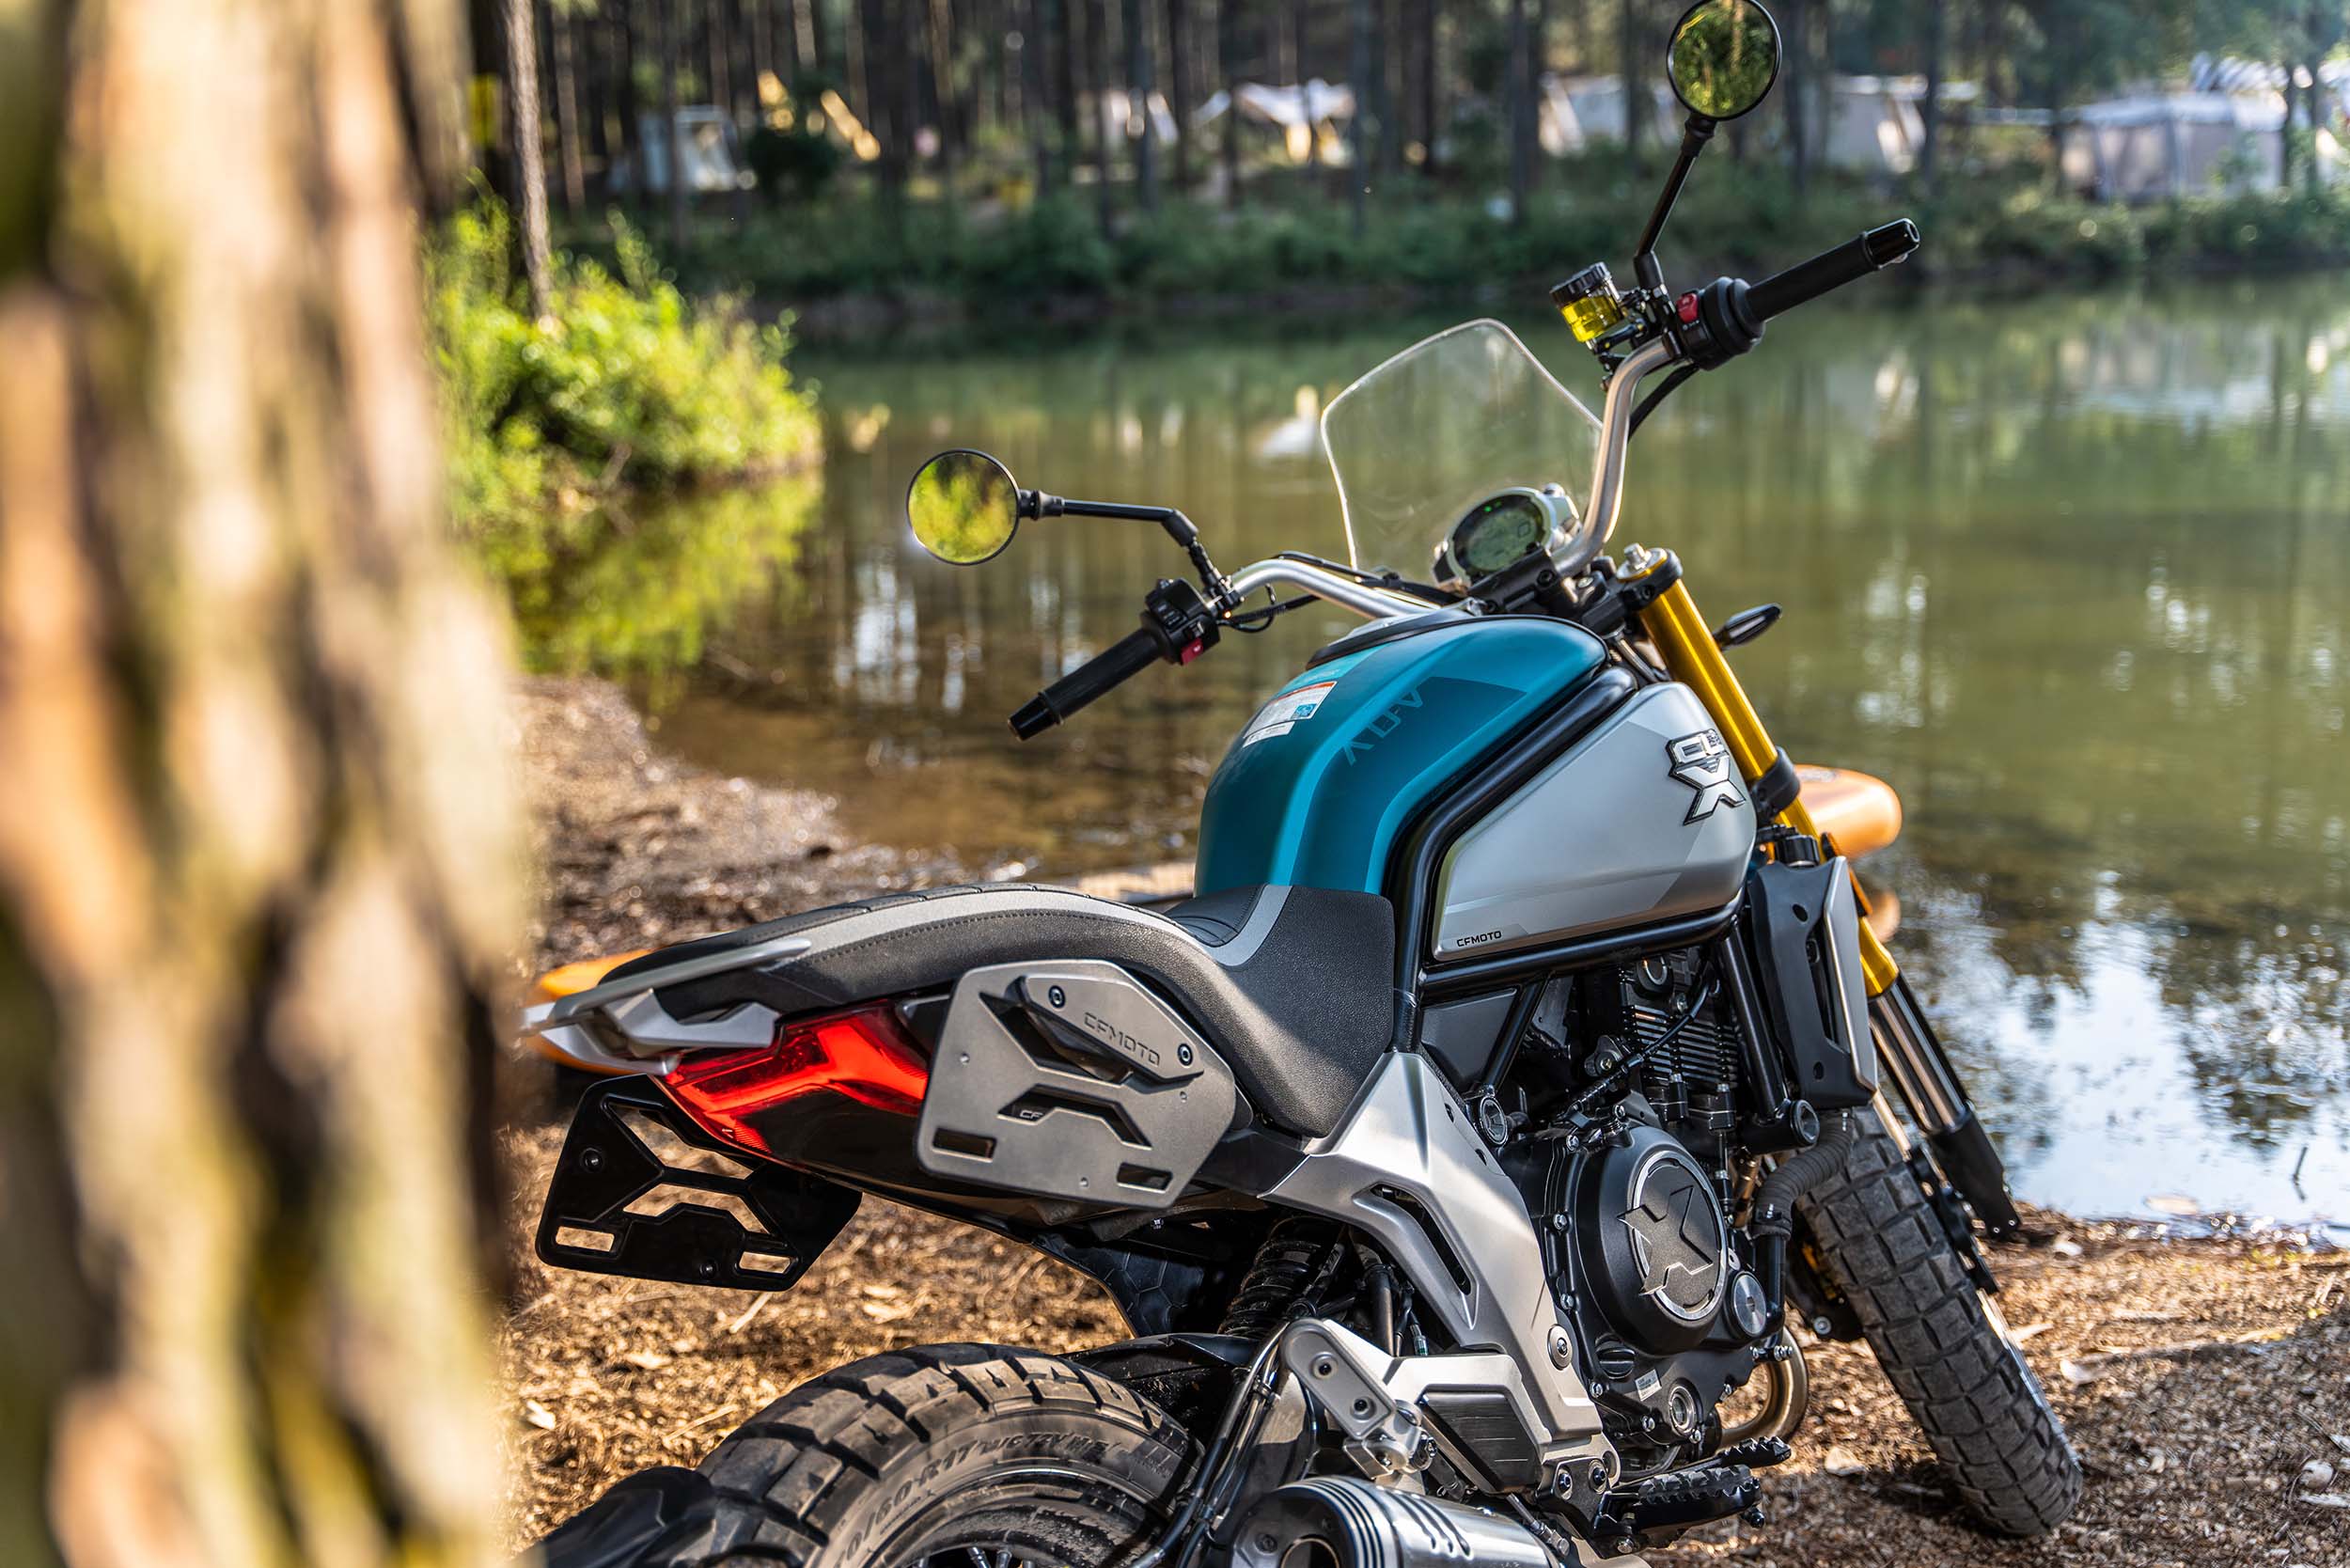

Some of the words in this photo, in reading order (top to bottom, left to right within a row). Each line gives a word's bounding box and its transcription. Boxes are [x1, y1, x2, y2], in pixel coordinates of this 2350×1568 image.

[1342, 688, 1424, 766] ADV
[1456, 930, 1503, 948] CFMOTO
[1083, 1011, 1162, 1067] CFMOTO
